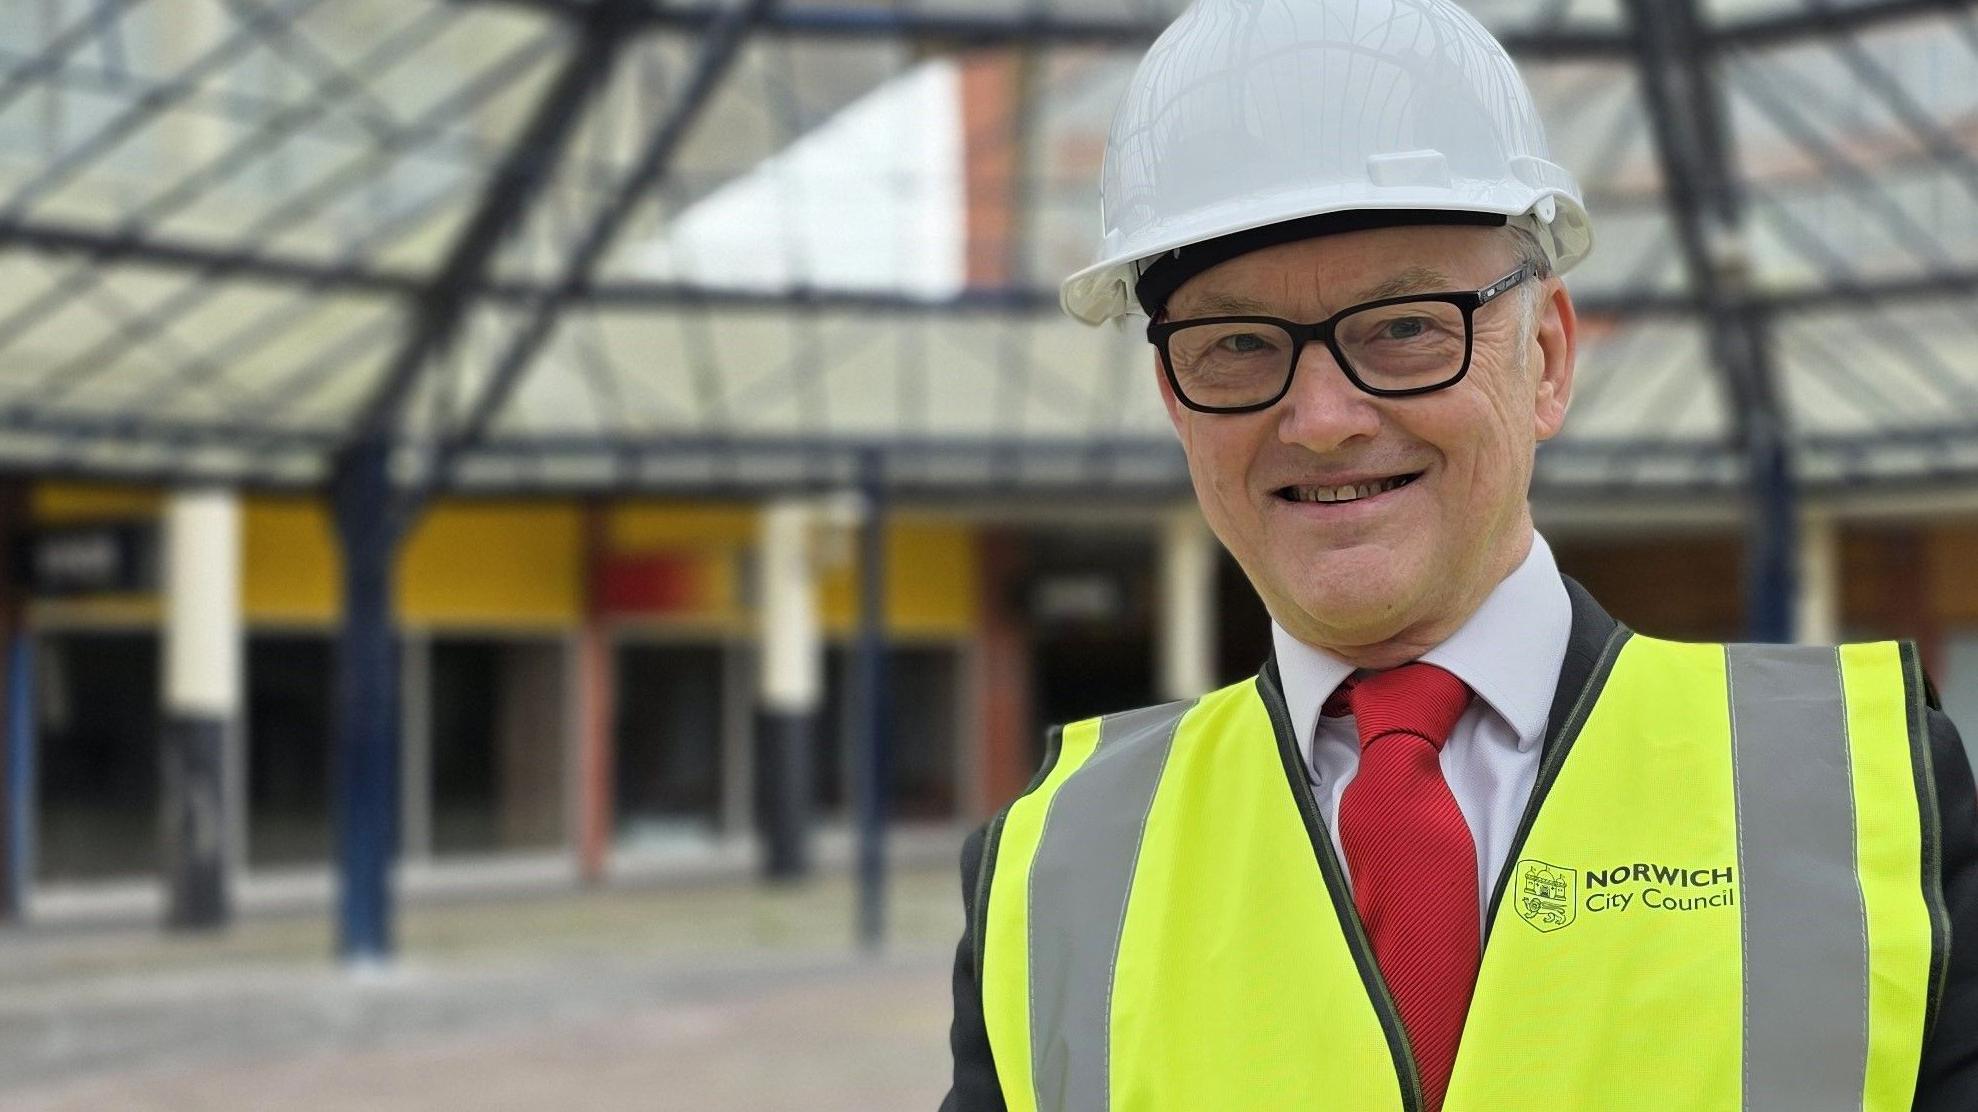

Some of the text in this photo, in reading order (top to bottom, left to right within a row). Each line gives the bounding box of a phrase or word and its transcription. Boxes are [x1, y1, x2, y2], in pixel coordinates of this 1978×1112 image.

[1586, 863, 1733, 889] NORWICH
[1586, 888, 1734, 912] City Council
